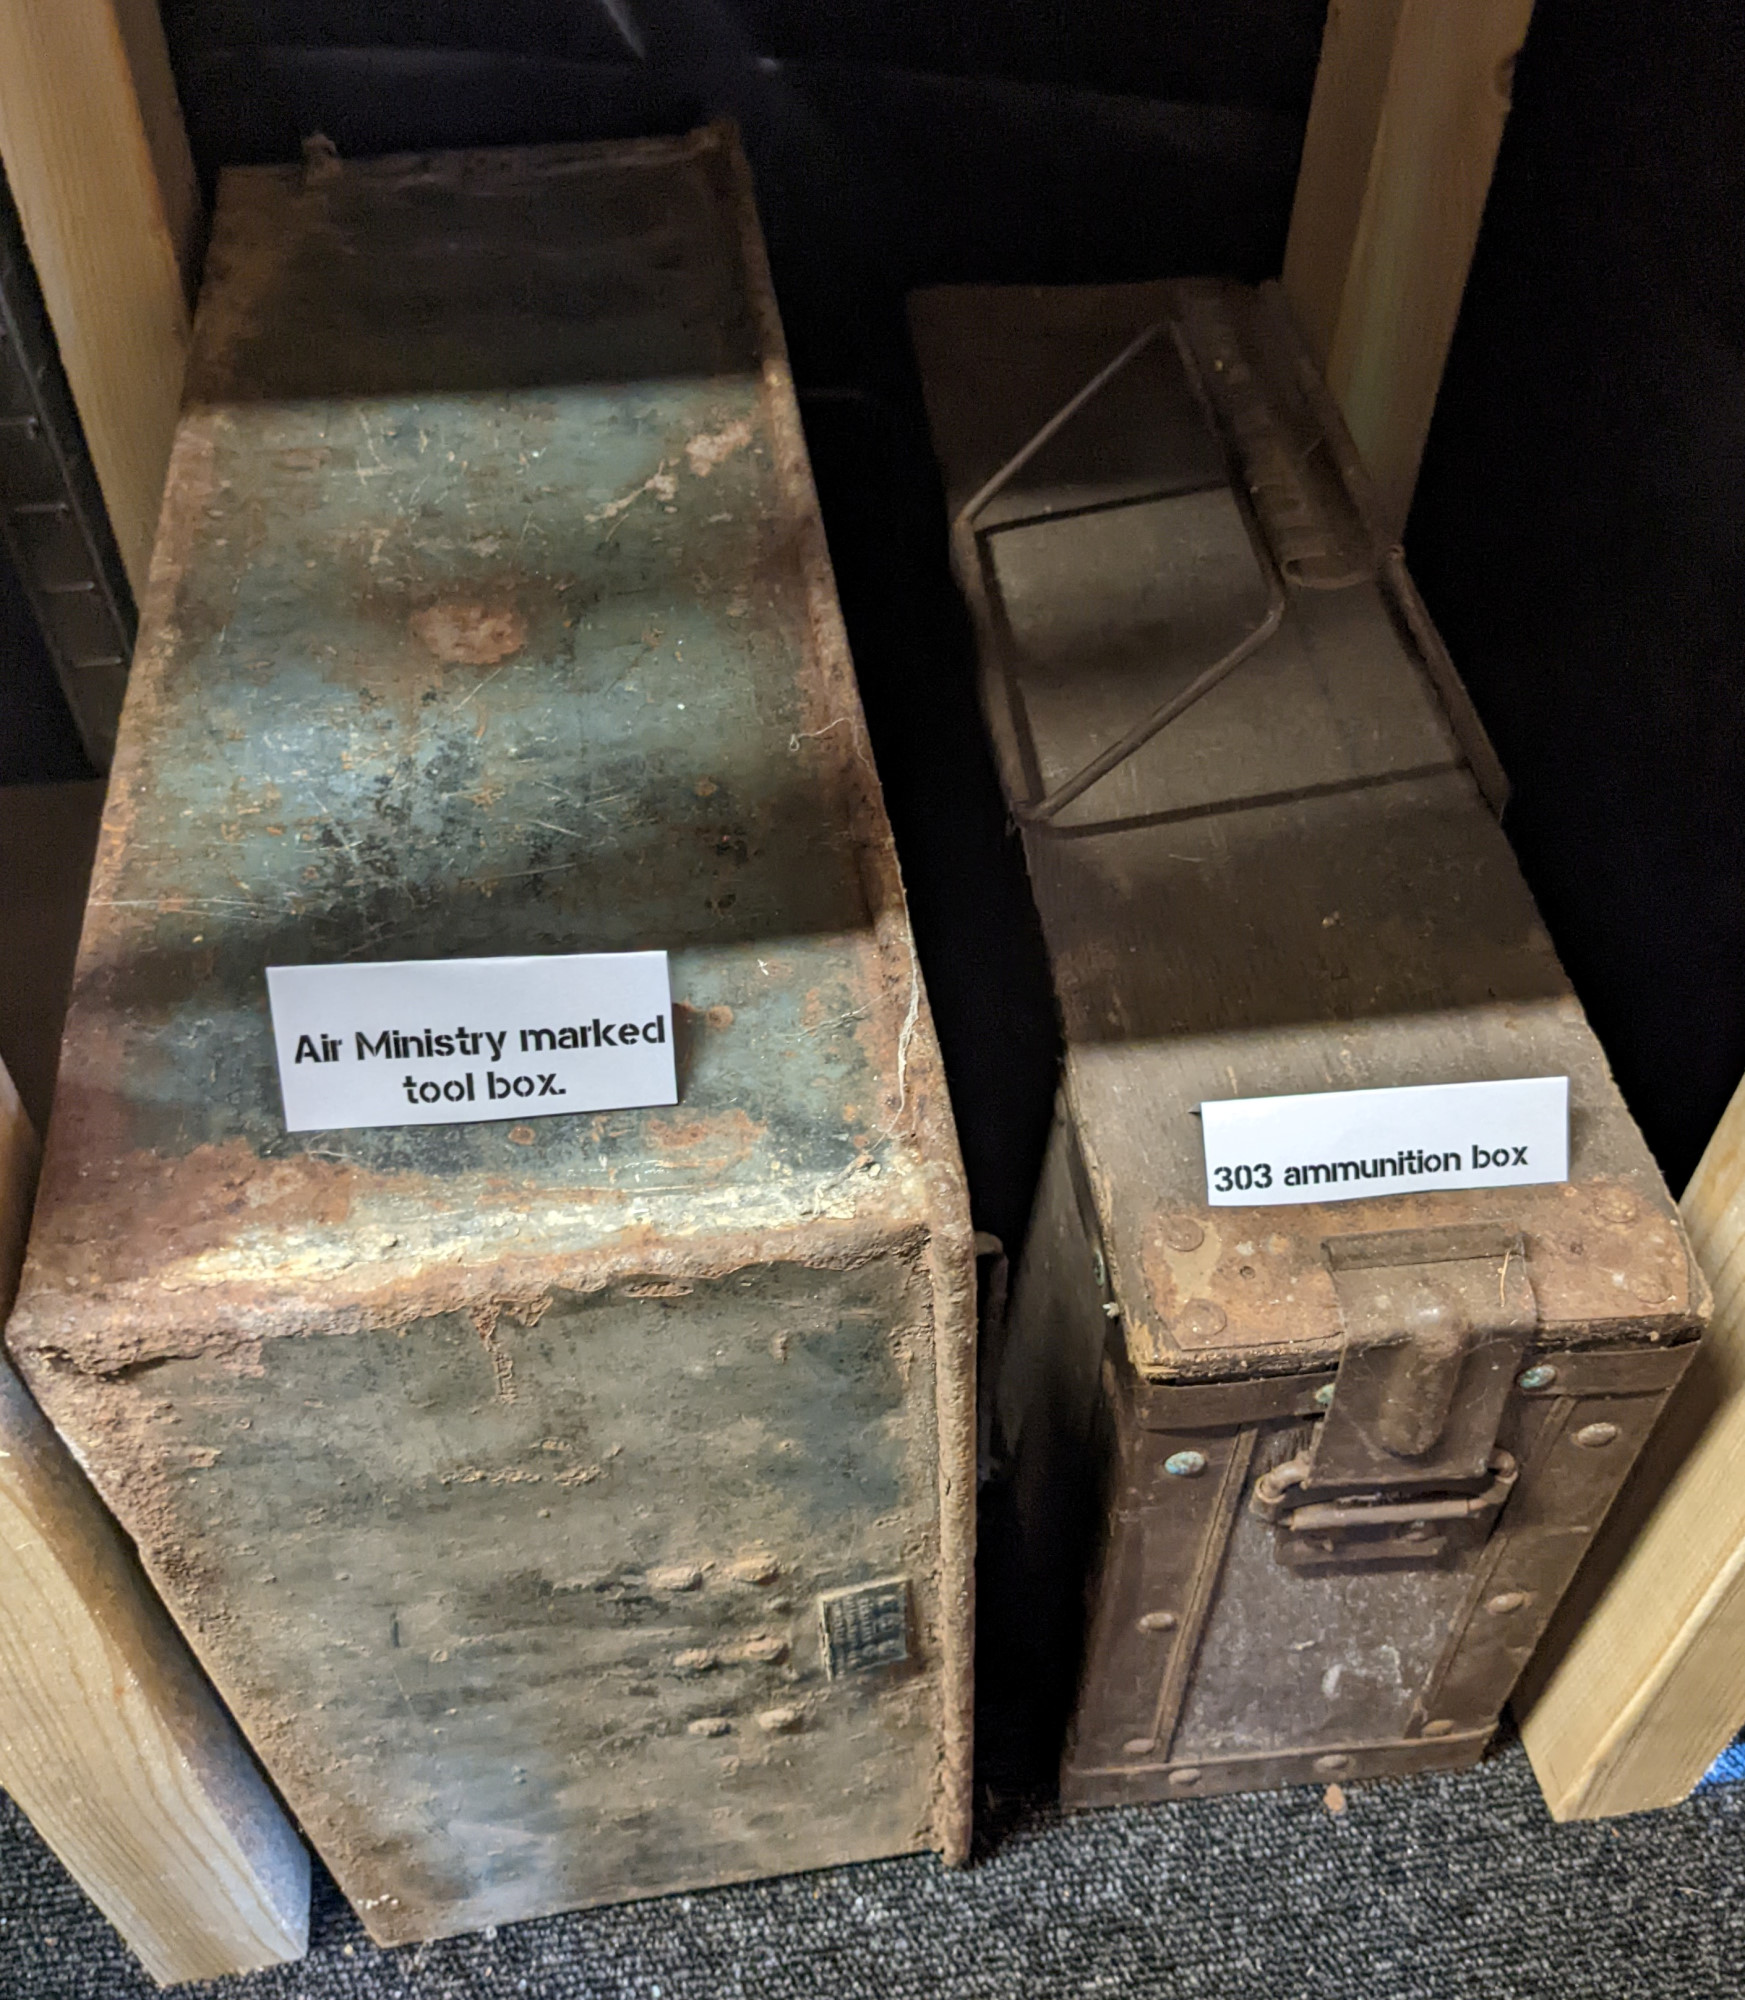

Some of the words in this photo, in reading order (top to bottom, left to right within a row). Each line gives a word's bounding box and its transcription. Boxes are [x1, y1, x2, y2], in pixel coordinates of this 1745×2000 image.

[295, 1033, 343, 1064] Air
[355, 1026, 507, 1062] Ministry
[519, 1014, 666, 1052] marked
[402, 1072, 475, 1104] tool
[486, 1071, 567, 1100] box.
[1214, 1163, 1273, 1192] 303
[1284, 1150, 1462, 1187] ammunition
[1472, 1144, 1528, 1170] box
